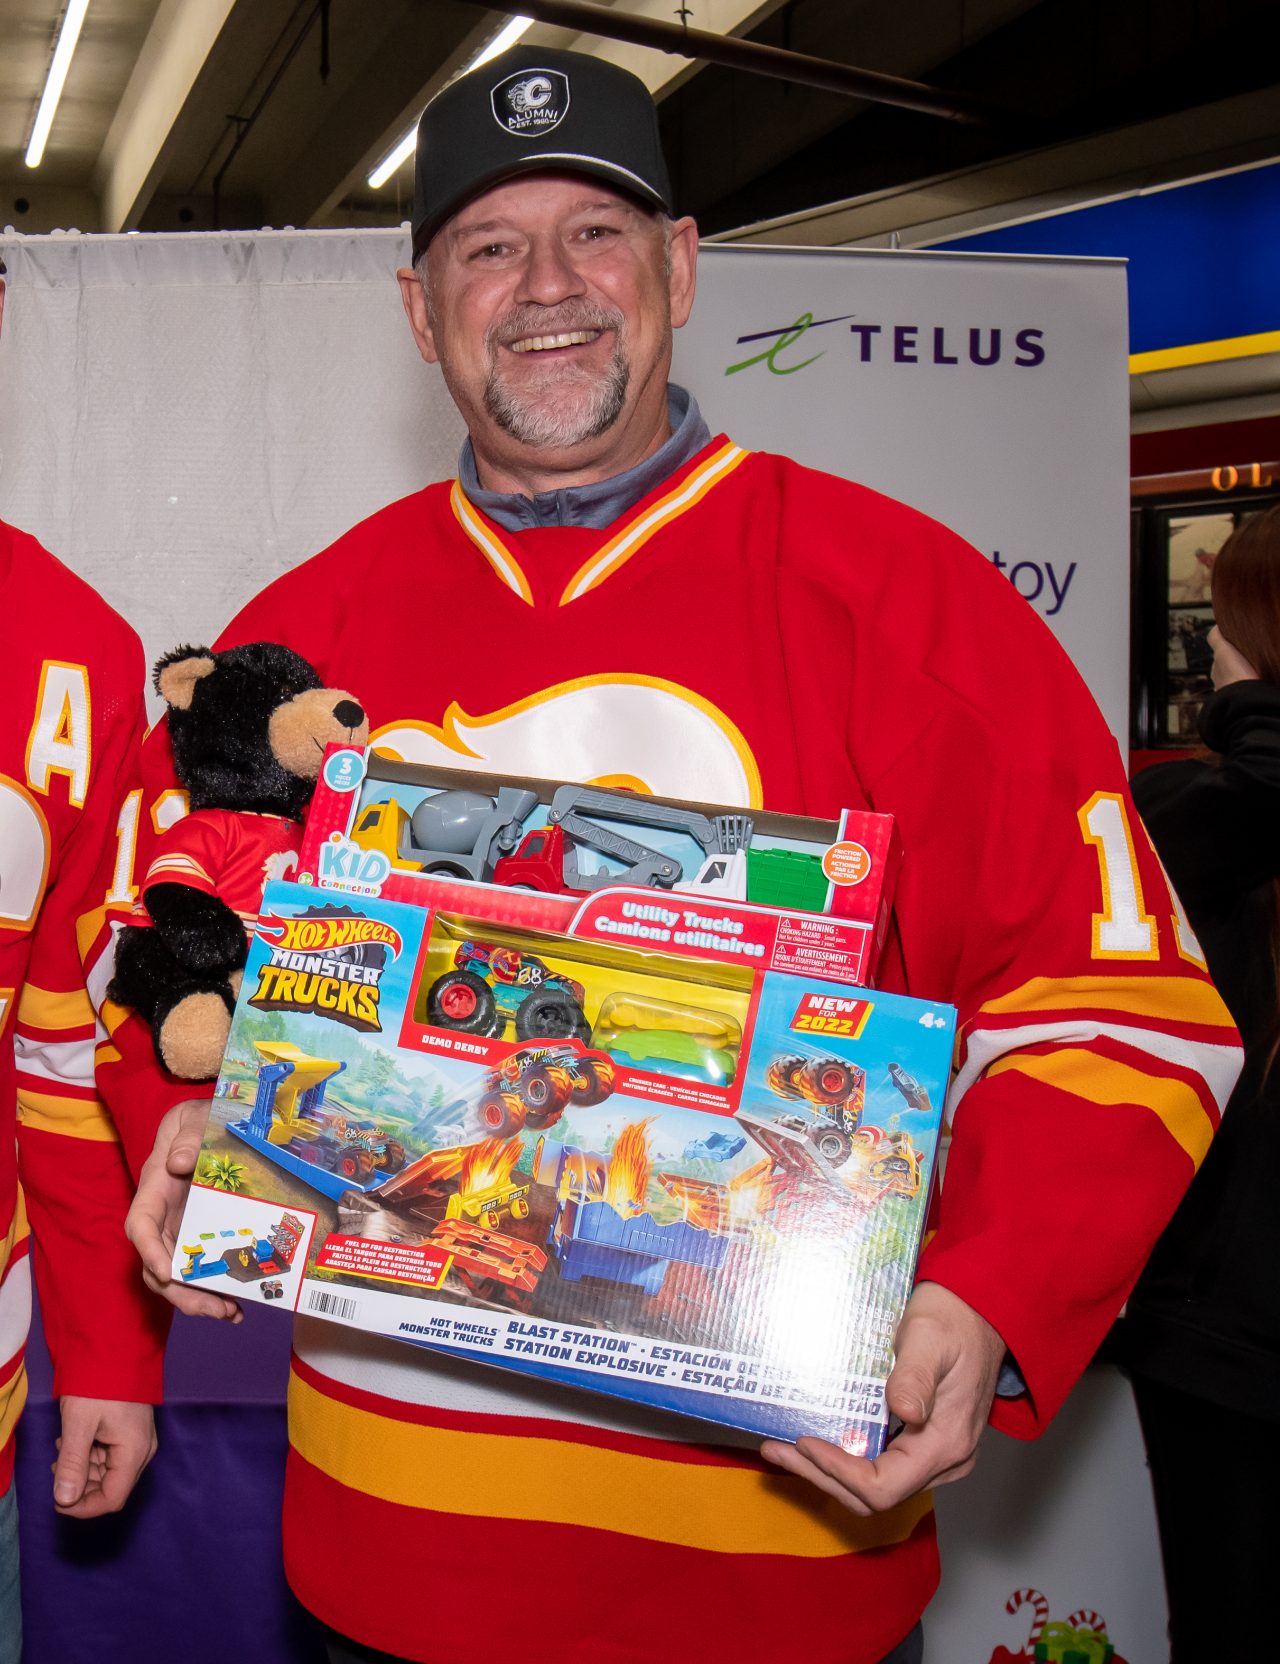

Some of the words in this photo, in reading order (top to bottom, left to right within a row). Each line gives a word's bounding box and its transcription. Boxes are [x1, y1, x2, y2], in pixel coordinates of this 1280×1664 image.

[508, 109, 558, 128] ALUMNI
[851, 325, 1046, 367] TELUS
[25, 660, 92, 810] A
[339, 758, 352, 775] 3
[321, 880, 378, 895] Connection
[622, 901, 680, 927] Utility
[682, 910, 744, 935] Trucks
[594, 915, 671, 942] Camions
[673, 930, 765, 957] utilitaires
[272, 949, 384, 985] MONSTER
[256, 965, 380, 1024] TRUCKS
[808, 996, 858, 1012] NEW
[795, 1014, 854, 1034] 2022
[818, 1010, 837, 1018] FOR
[918, 1012, 946, 1028] 4+
[422, 1034, 452, 1049] DEMO
[453, 1042, 489, 1056] DERBY
[345, 1240, 360, 1248] FUEL
[383, 1246, 425, 1258] DESTRUCTION
[377, 1252, 394, 1260] PARA
[332, 1252, 353, 1261] FAITES
[362, 1257, 380, 1265] PLEIN
[390, 1262, 432, 1274] DESTRUCTION
[356, 1263, 372, 1272] PARA
[398, 1322, 450, 1339] MONSTER
[452, 1331, 495, 1347] TRUCKS
[429, 1317, 452, 1328] HOT
[454, 1321, 498, 1337] WHEELS
[506, 1320, 559, 1340] BLAST
[650, 1345, 732, 1372] ESTACIÓN
[503, 1338, 571, 1361] STATION
[575, 1350, 668, 1378] EXPLOSIVE
[681, 1369, 758, 1394] ESTAÇÃO
